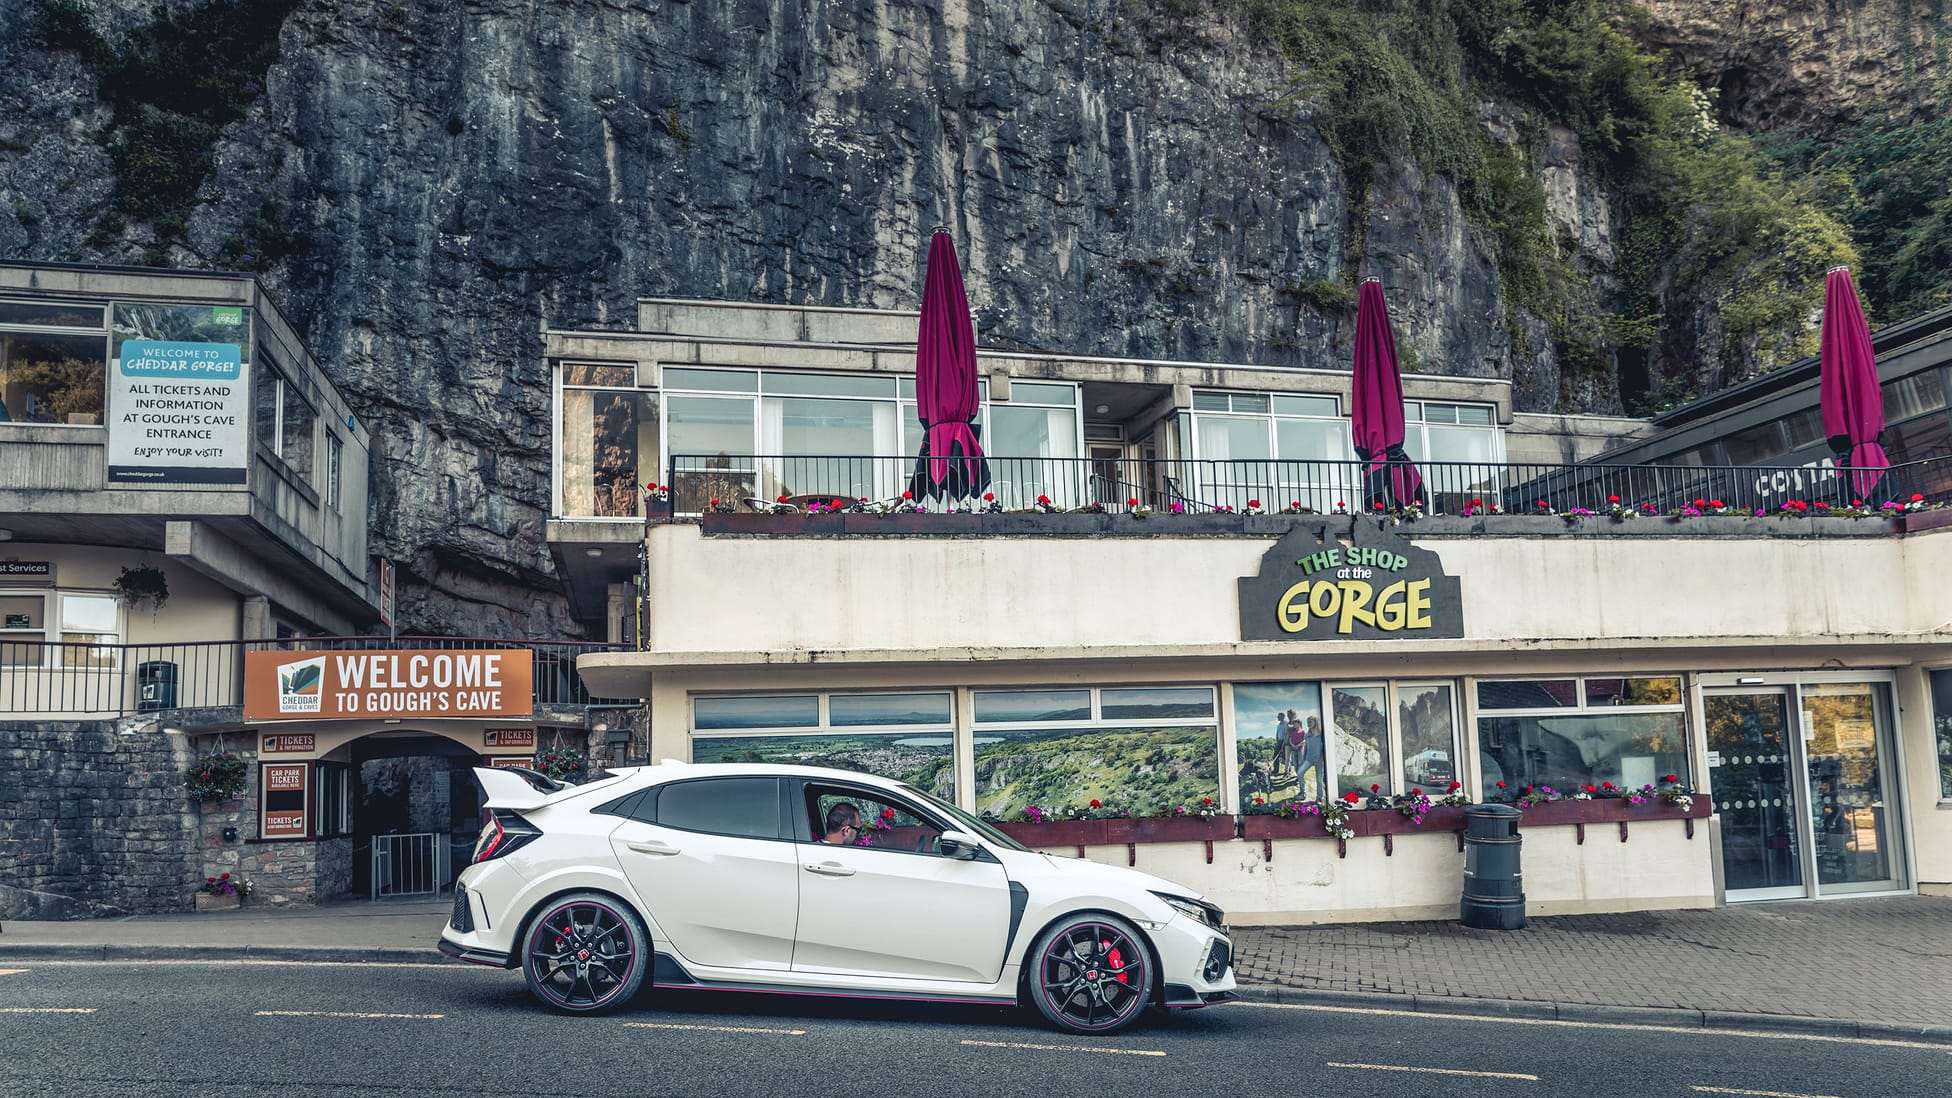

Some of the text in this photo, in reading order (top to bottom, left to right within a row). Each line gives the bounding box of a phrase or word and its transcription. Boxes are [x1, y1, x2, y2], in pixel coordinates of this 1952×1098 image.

[216, 316, 239, 325] GORGE
[143, 348, 219, 359] WELCOME TO
[126, 358, 234, 373] CHEDDAR GORGE!
[129, 384, 231, 397] ALL TICKETS AND
[136, 399, 224, 411] INFORMATION
[123, 413, 235, 426] AT GOUGH'S CAVE
[146, 428, 212, 440] ENTRANCE
[166, 448, 192, 457] YOUR
[1297, 546, 1408, 575] THE SHOP
[8, 563, 47, 572] Services
[1337, 567, 1372, 579] at the
[1277, 577, 1432, 634] GORGE
[336, 654, 502, 689] WELCOME
[282, 696, 319, 704] CHEDDAR
[336, 691, 502, 712] TO GOUGH'S CAVE
[280, 735, 313, 745] TICKETS
[500, 730, 532, 739] TICKETS
[271, 776, 299, 784] TICKETS
[267, 817, 292, 825] TICKETS
